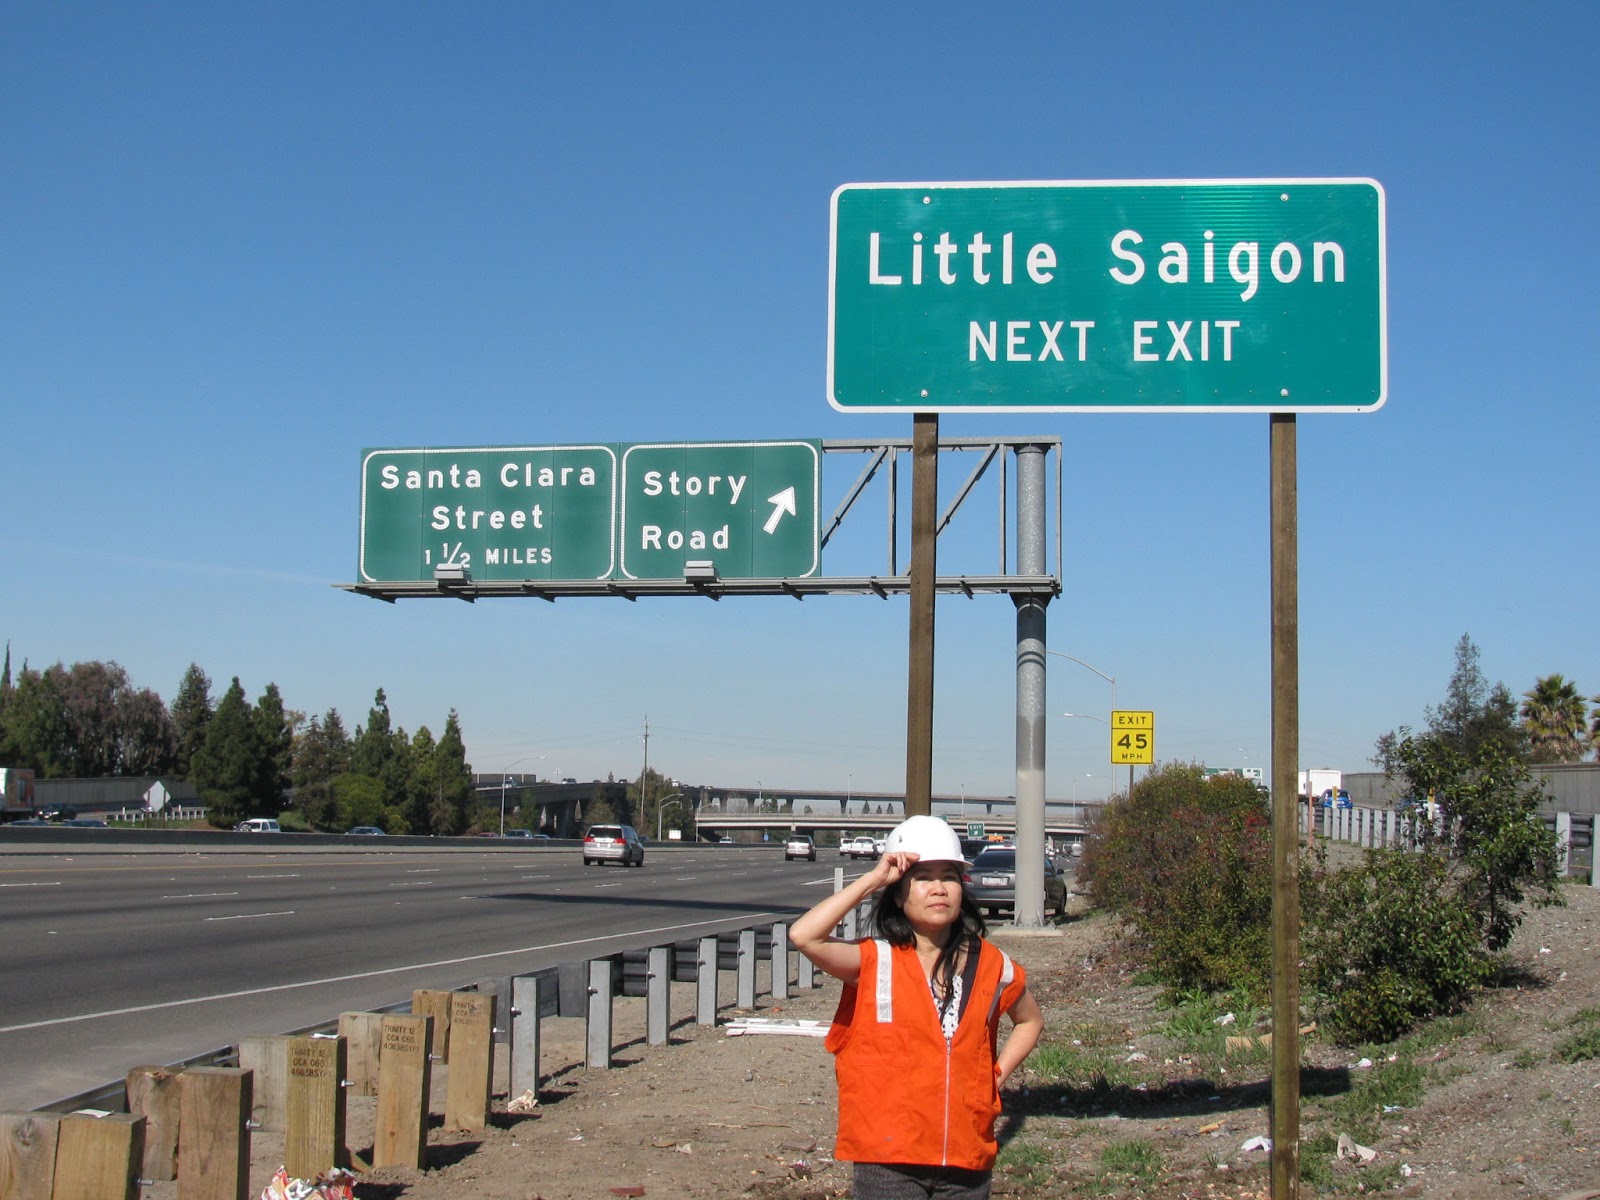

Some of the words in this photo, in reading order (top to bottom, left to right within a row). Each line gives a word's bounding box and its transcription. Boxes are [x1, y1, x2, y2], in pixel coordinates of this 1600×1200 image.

[868, 231, 1058, 286] Little
[1108, 229, 1346, 303] Saigon
[968, 320, 1096, 362] NEXT
[1133, 320, 1241, 362] EXIT
[381, 463, 482, 490] Santa
[500, 462, 596, 488] Clara
[643, 470, 747, 505] Story
[431, 503, 544, 531] Street
[642, 524, 729, 550] Road
[485, 547, 553, 565] MILES
[1118, 716, 1147, 725] EXIT
[1117, 733, 1148, 750] 45
[384, 1024, 407, 1034] TRINITY
[386, 1033, 399, 1042] CCA
